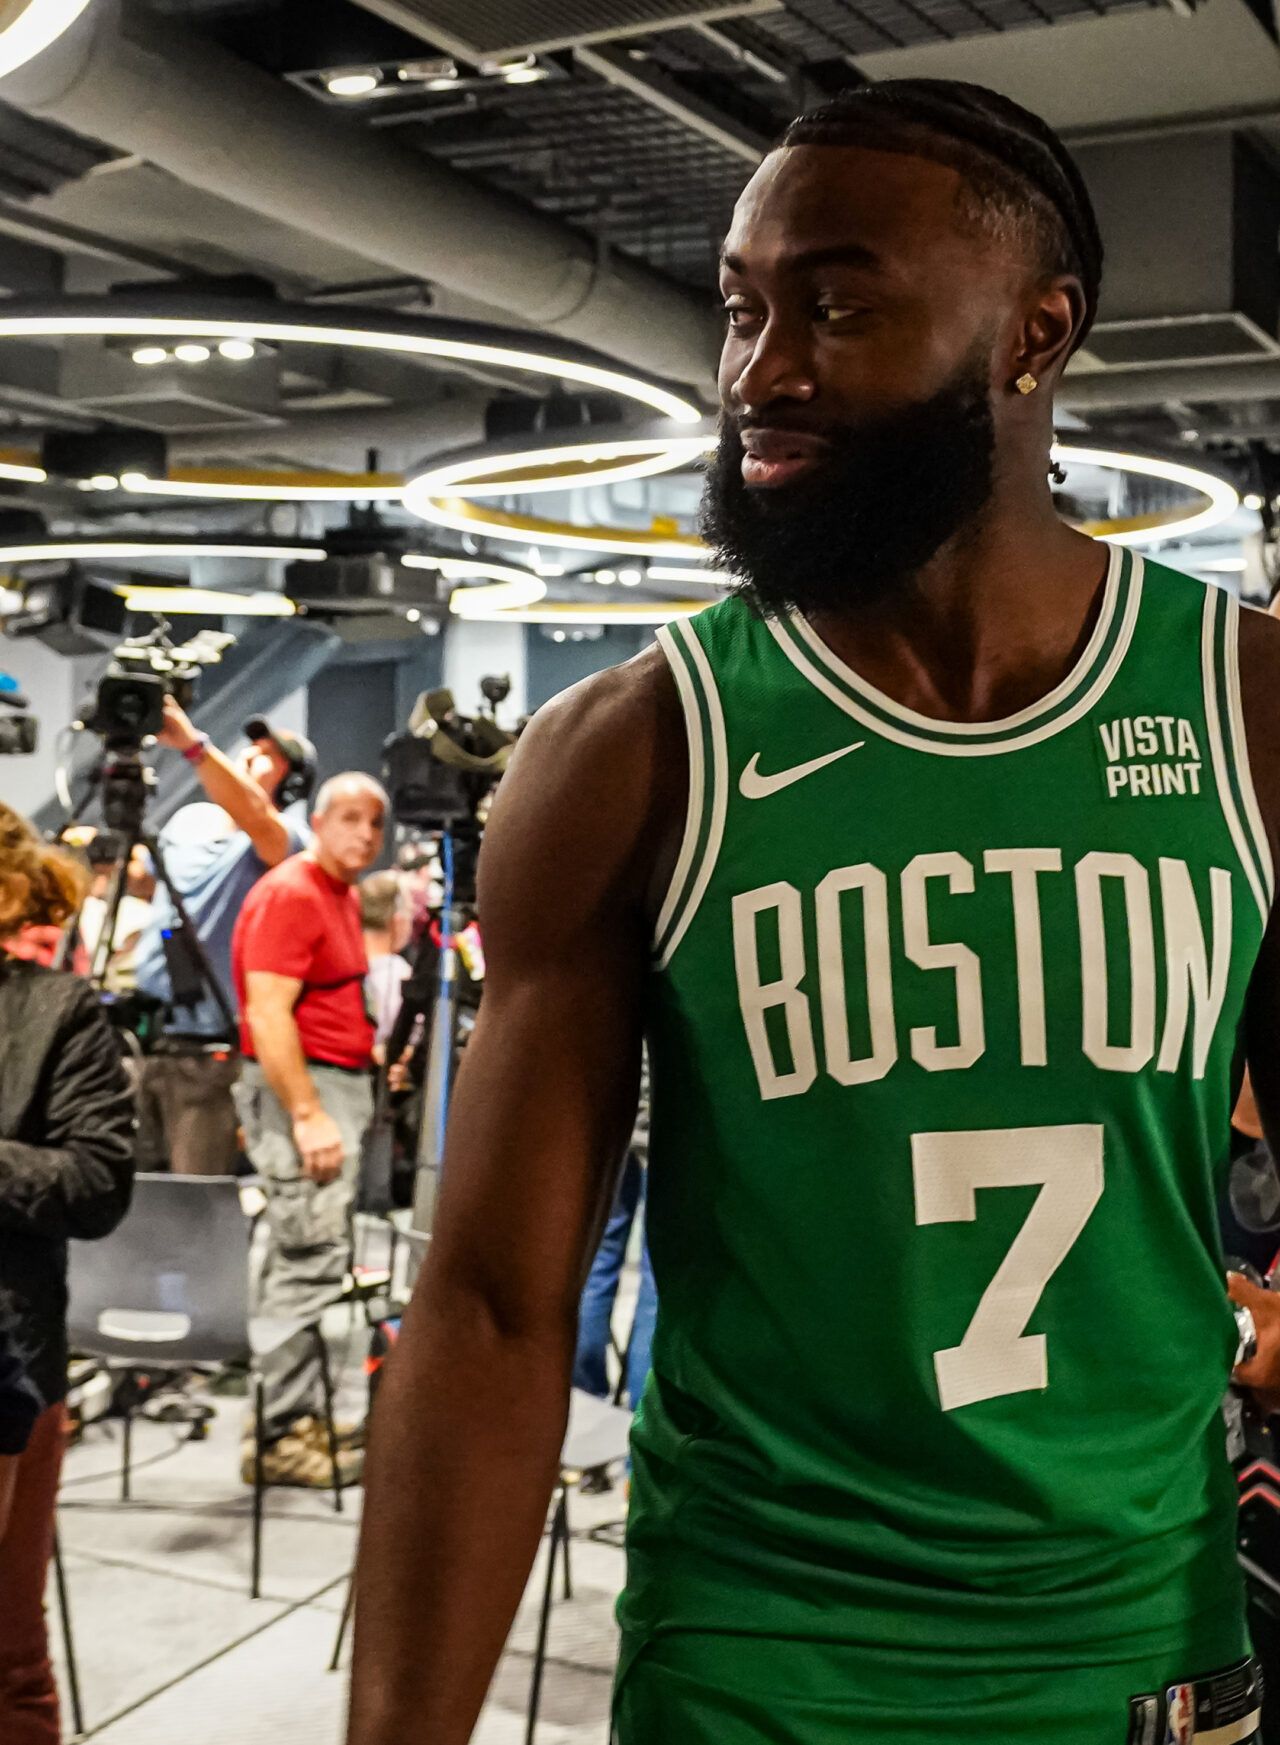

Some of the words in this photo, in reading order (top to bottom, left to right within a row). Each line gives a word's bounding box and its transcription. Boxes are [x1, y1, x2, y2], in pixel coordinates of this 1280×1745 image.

[1099, 715, 1201, 762] VISTA
[1106, 762, 1202, 798] PRINT
[731, 847, 1232, 1100] BOSTON
[910, 1123, 1105, 1412] 7
